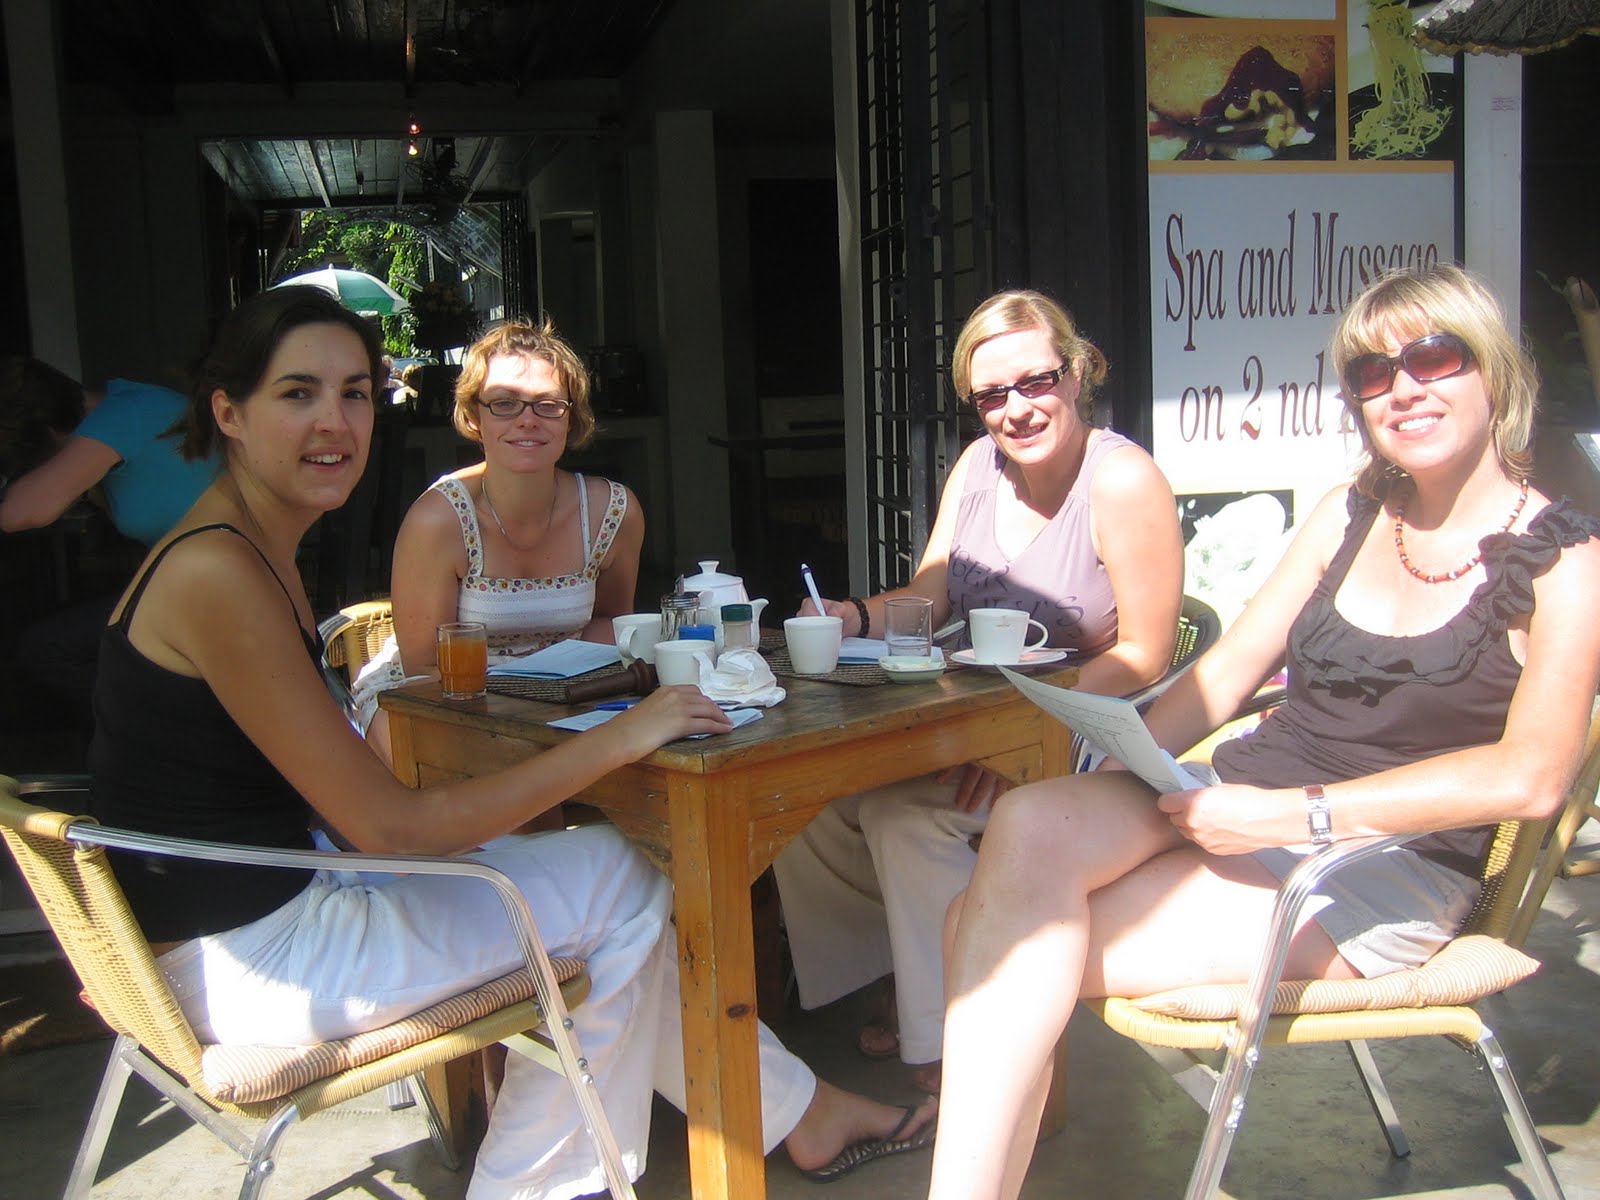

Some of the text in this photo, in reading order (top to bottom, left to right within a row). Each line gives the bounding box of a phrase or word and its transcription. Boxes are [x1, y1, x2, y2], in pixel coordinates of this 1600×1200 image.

[1165, 213, 1226, 351] Spa
[1239, 208, 1296, 319] and
[1179, 384, 1226, 443] on
[1240, 355, 1265, 441] 2
[1278, 350, 1325, 438] nd
